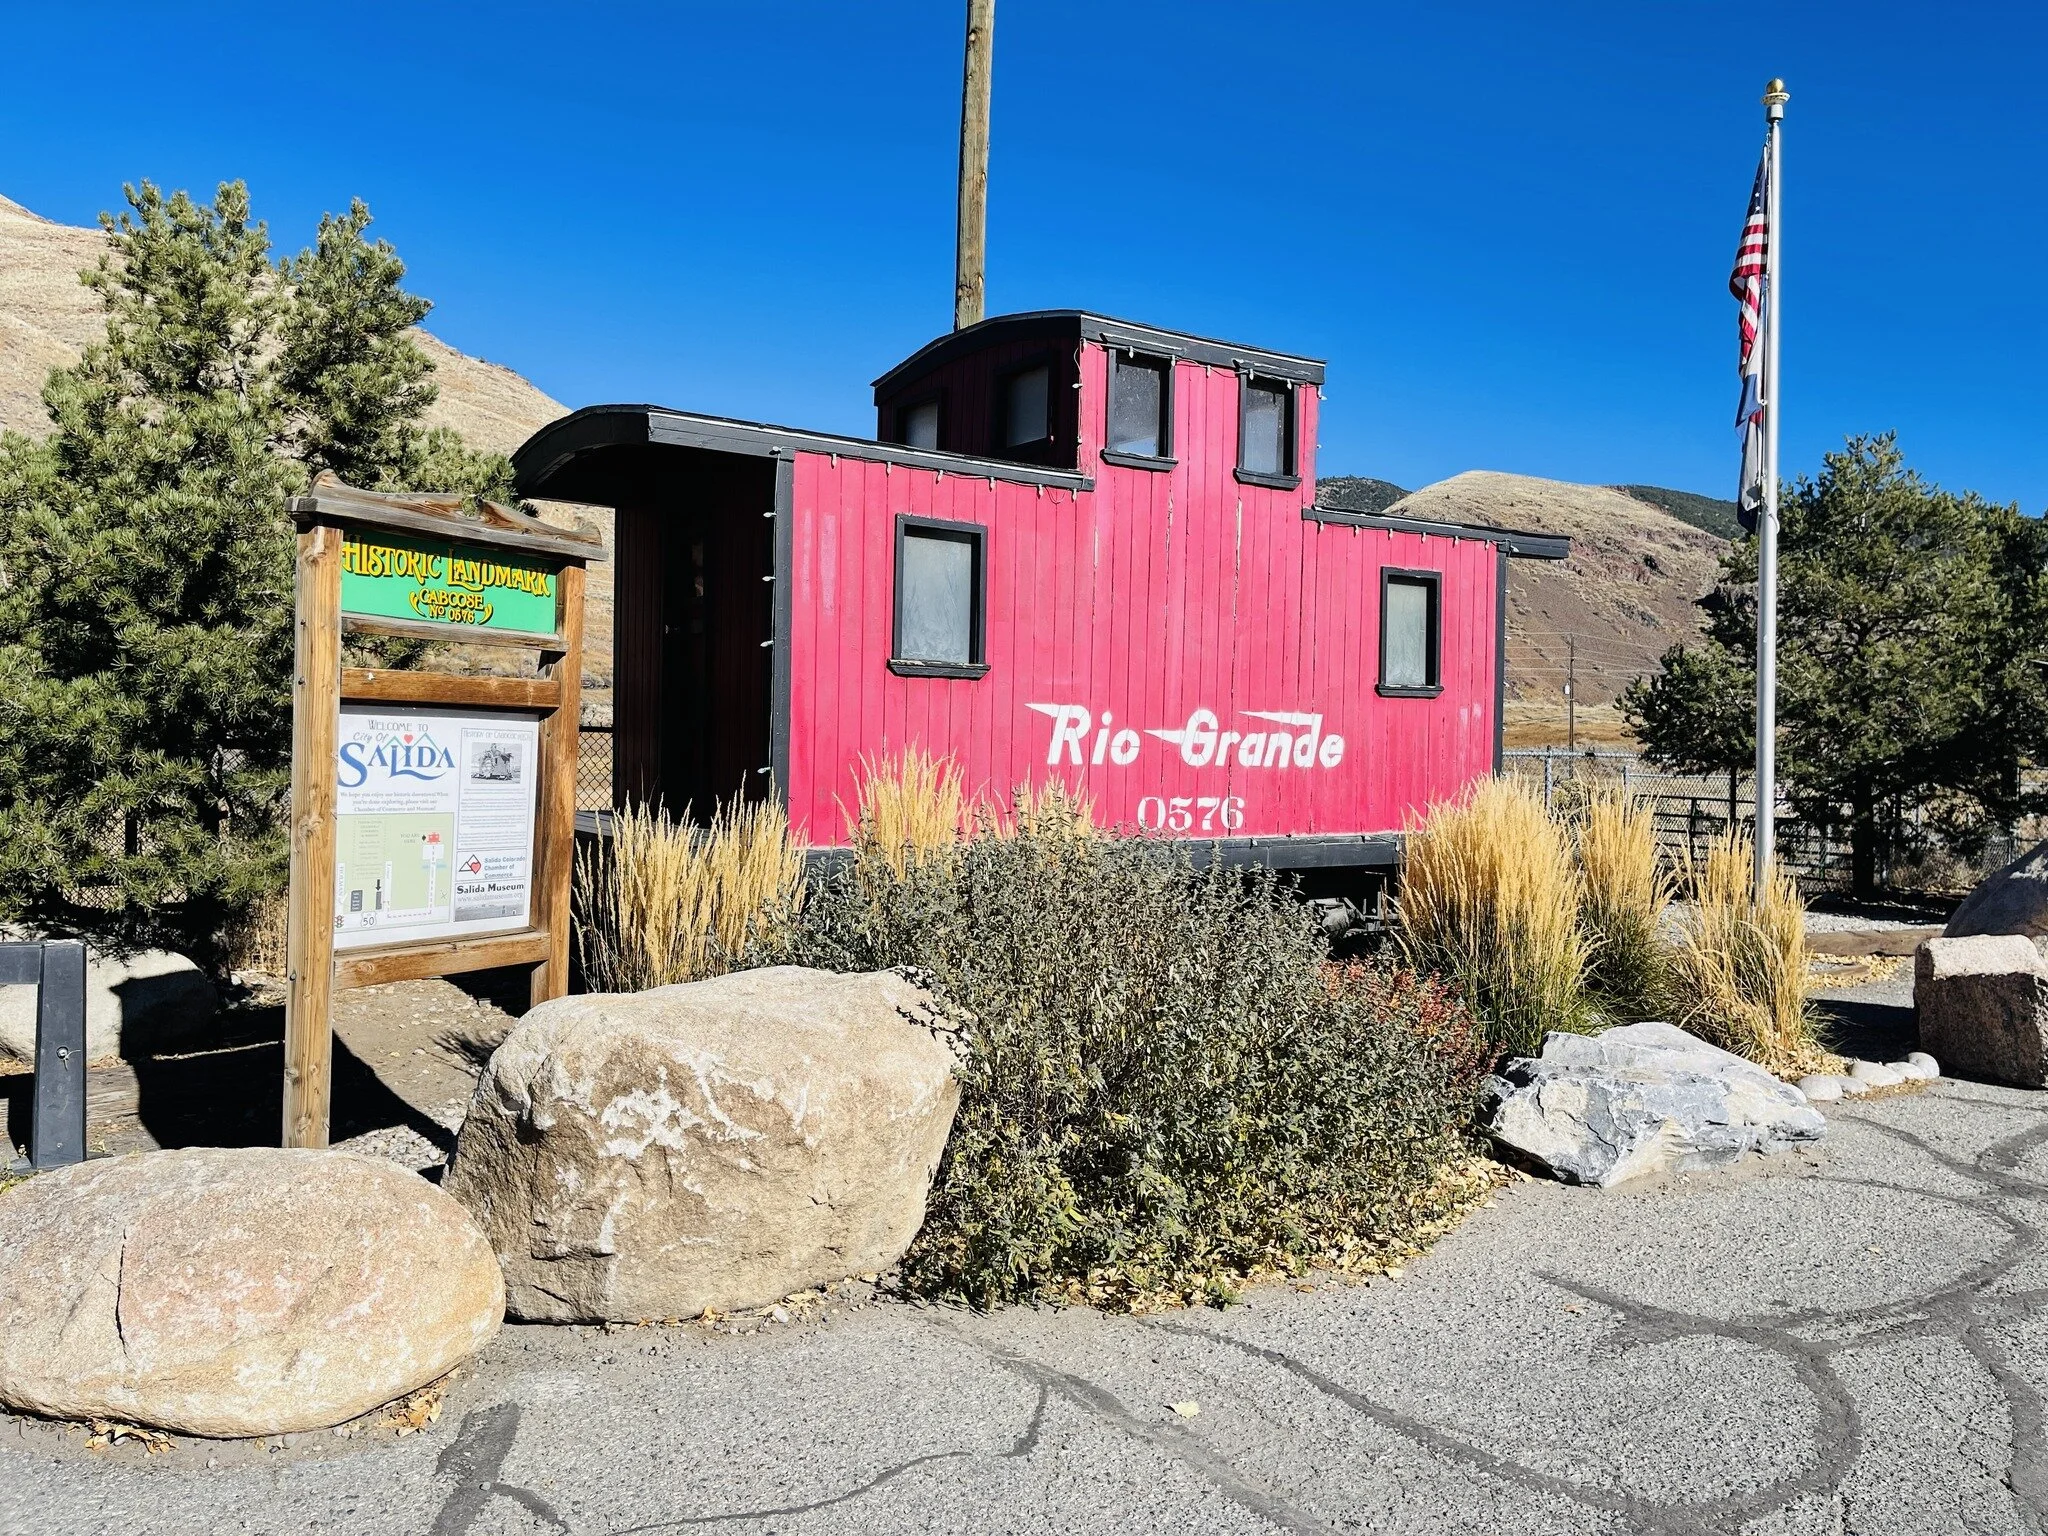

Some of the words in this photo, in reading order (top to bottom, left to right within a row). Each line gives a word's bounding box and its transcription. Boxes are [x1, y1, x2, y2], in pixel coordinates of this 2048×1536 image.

[342, 534, 442, 584] HISTORIC
[447, 549, 550, 596] LANDMARK
[448, 606, 475, 623] 0576
[368, 719, 412, 731] WELCOME
[418, 724, 428, 732] TO
[353, 732, 372, 743] City
[376, 733, 389, 743] Of
[1024, 702, 1141, 766] Rio
[1144, 708, 1345, 768] Grande
[337, 742, 455, 787] SALIDA
[1137, 796, 1246, 832] 0576
[457, 884, 485, 894] Salida
[488, 883, 524, 892] Museum
[363, 916, 375, 926] 50
